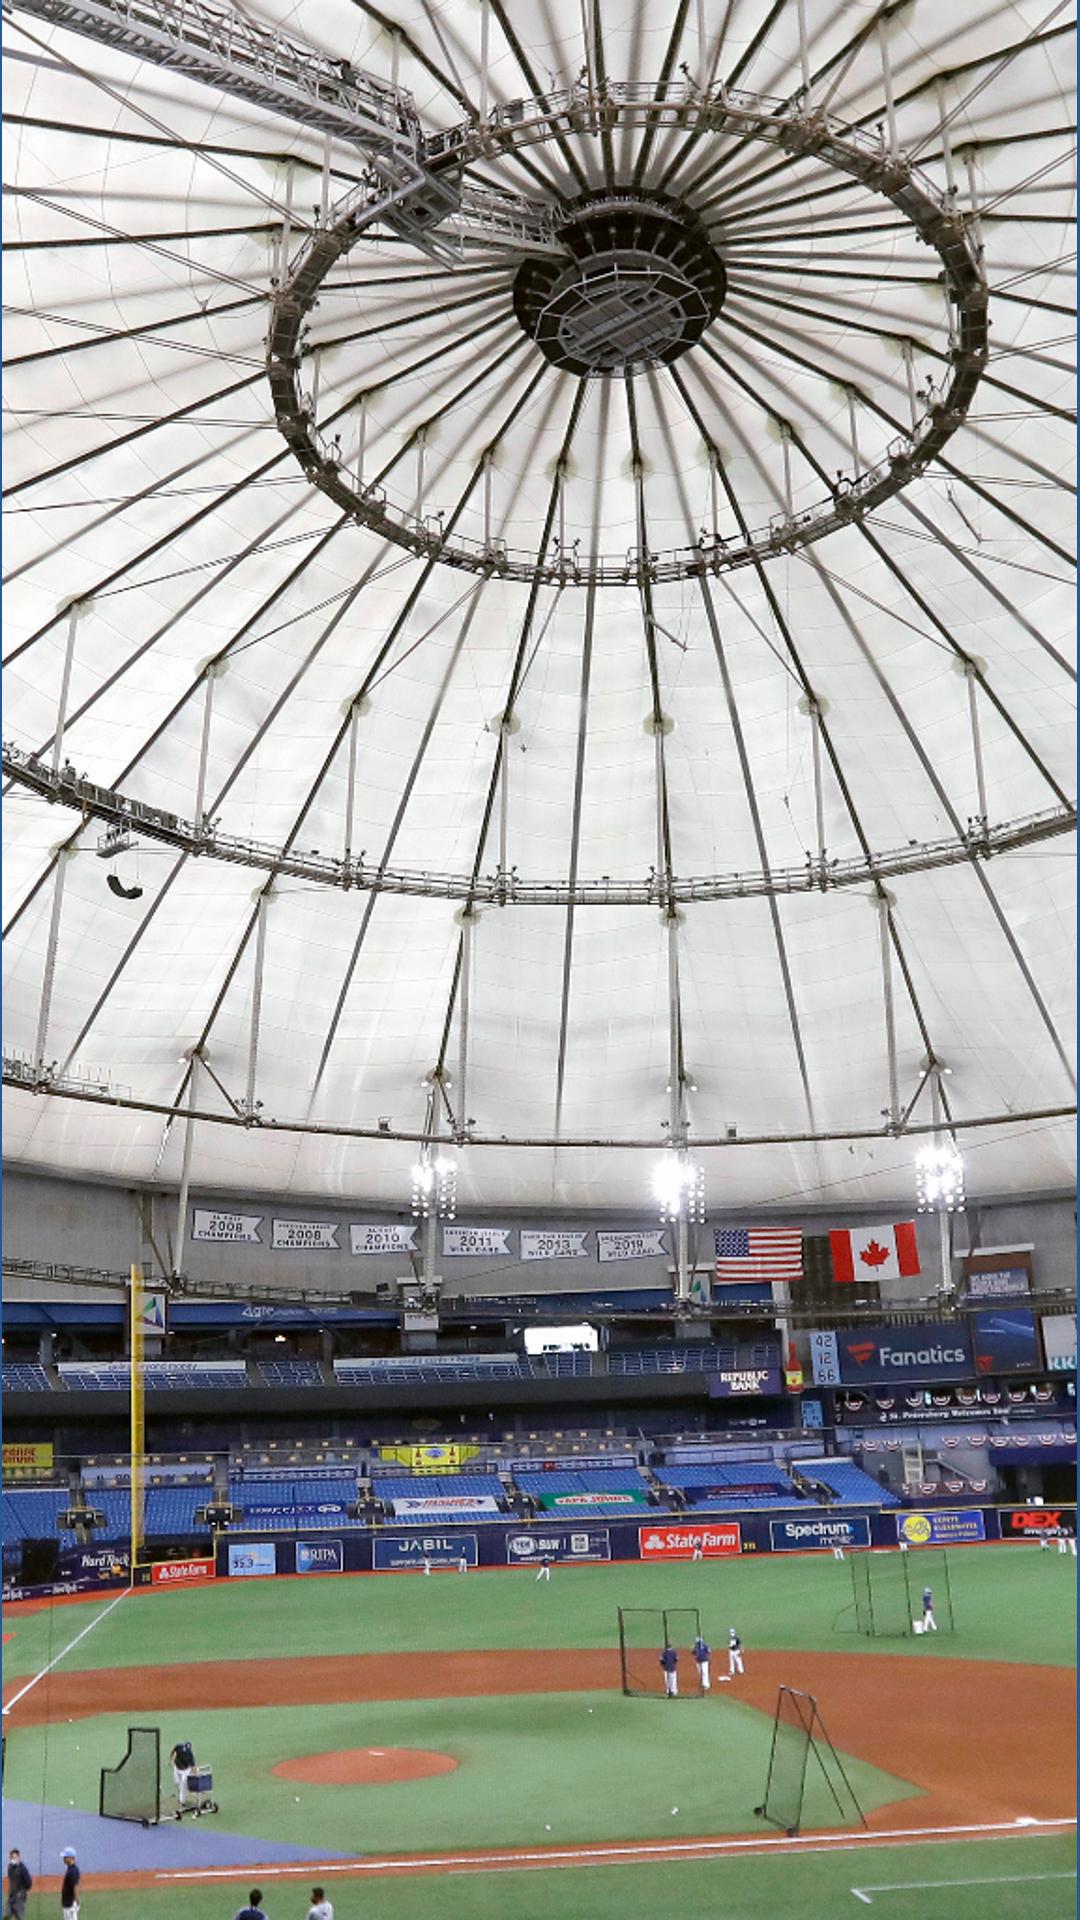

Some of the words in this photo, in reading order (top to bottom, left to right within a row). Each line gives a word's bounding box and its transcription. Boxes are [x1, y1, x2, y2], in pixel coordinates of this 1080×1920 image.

[209, 1220, 243, 1232] 2008
[198, 1230, 251, 1241] CHAMPIONS
[288, 1230, 321, 1240] 2008
[366, 1234, 400, 1243] 2010
[460, 1236, 492, 1246] 2011
[355, 1243, 409, 1251] CHAMPIONS
[537, 1239, 571, 1250] 2013
[815, 1335, 833, 1348] 42
[818, 1353, 833, 1365] 12
[879, 1344, 966, 1367] Fanatics
[731, 1382, 760, 1390] BANK
[1011, 1510, 1061, 1528] DEX
[785, 1522, 849, 1540] Spectrum
[398, 1539, 454, 1552] JABIL
[666, 1534, 701, 1548] State
[702, 1532, 736, 1547] Farm
[81, 1554, 106, 1567] Hard
[107, 1552, 130, 1567] Rock
